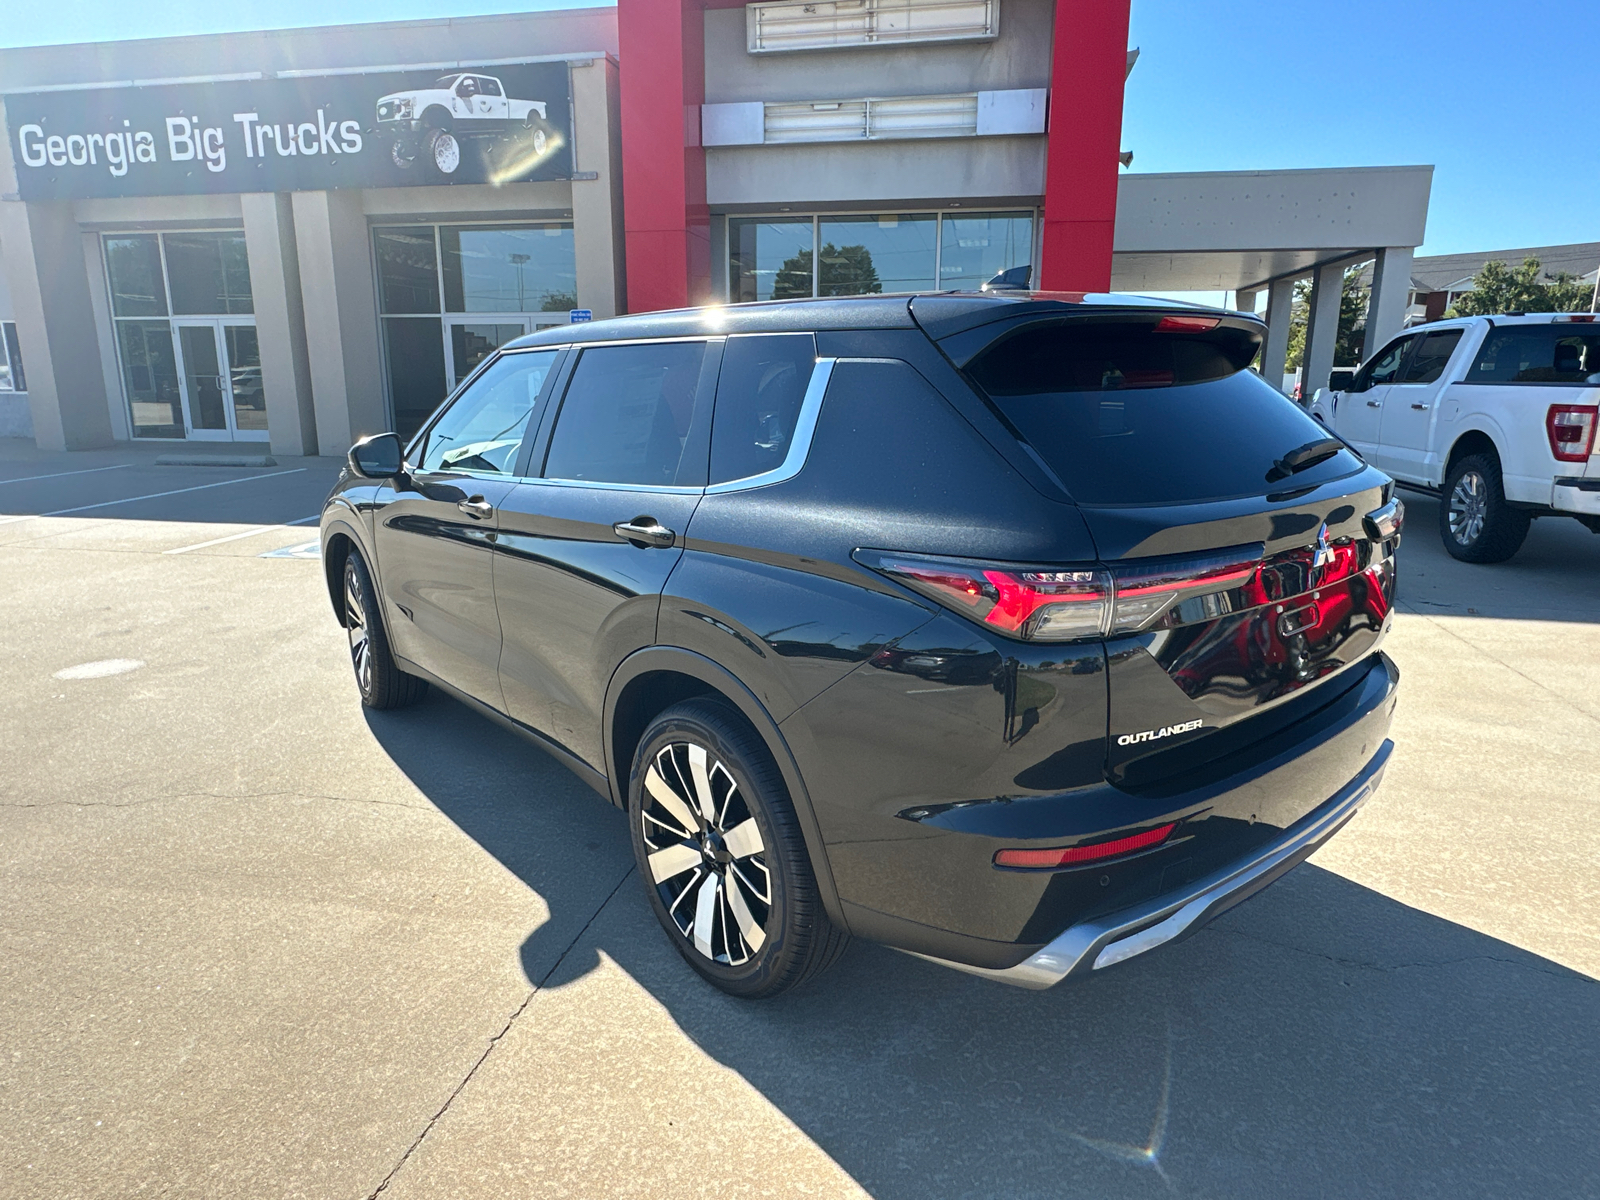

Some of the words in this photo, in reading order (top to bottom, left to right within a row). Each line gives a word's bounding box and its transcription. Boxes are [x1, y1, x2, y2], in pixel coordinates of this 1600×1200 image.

[18, 119, 157, 178] Georgia
[165, 115, 227, 173] Big
[233, 109, 363, 158] Trucks
[1117, 718, 1203, 746] OUTLANDER
